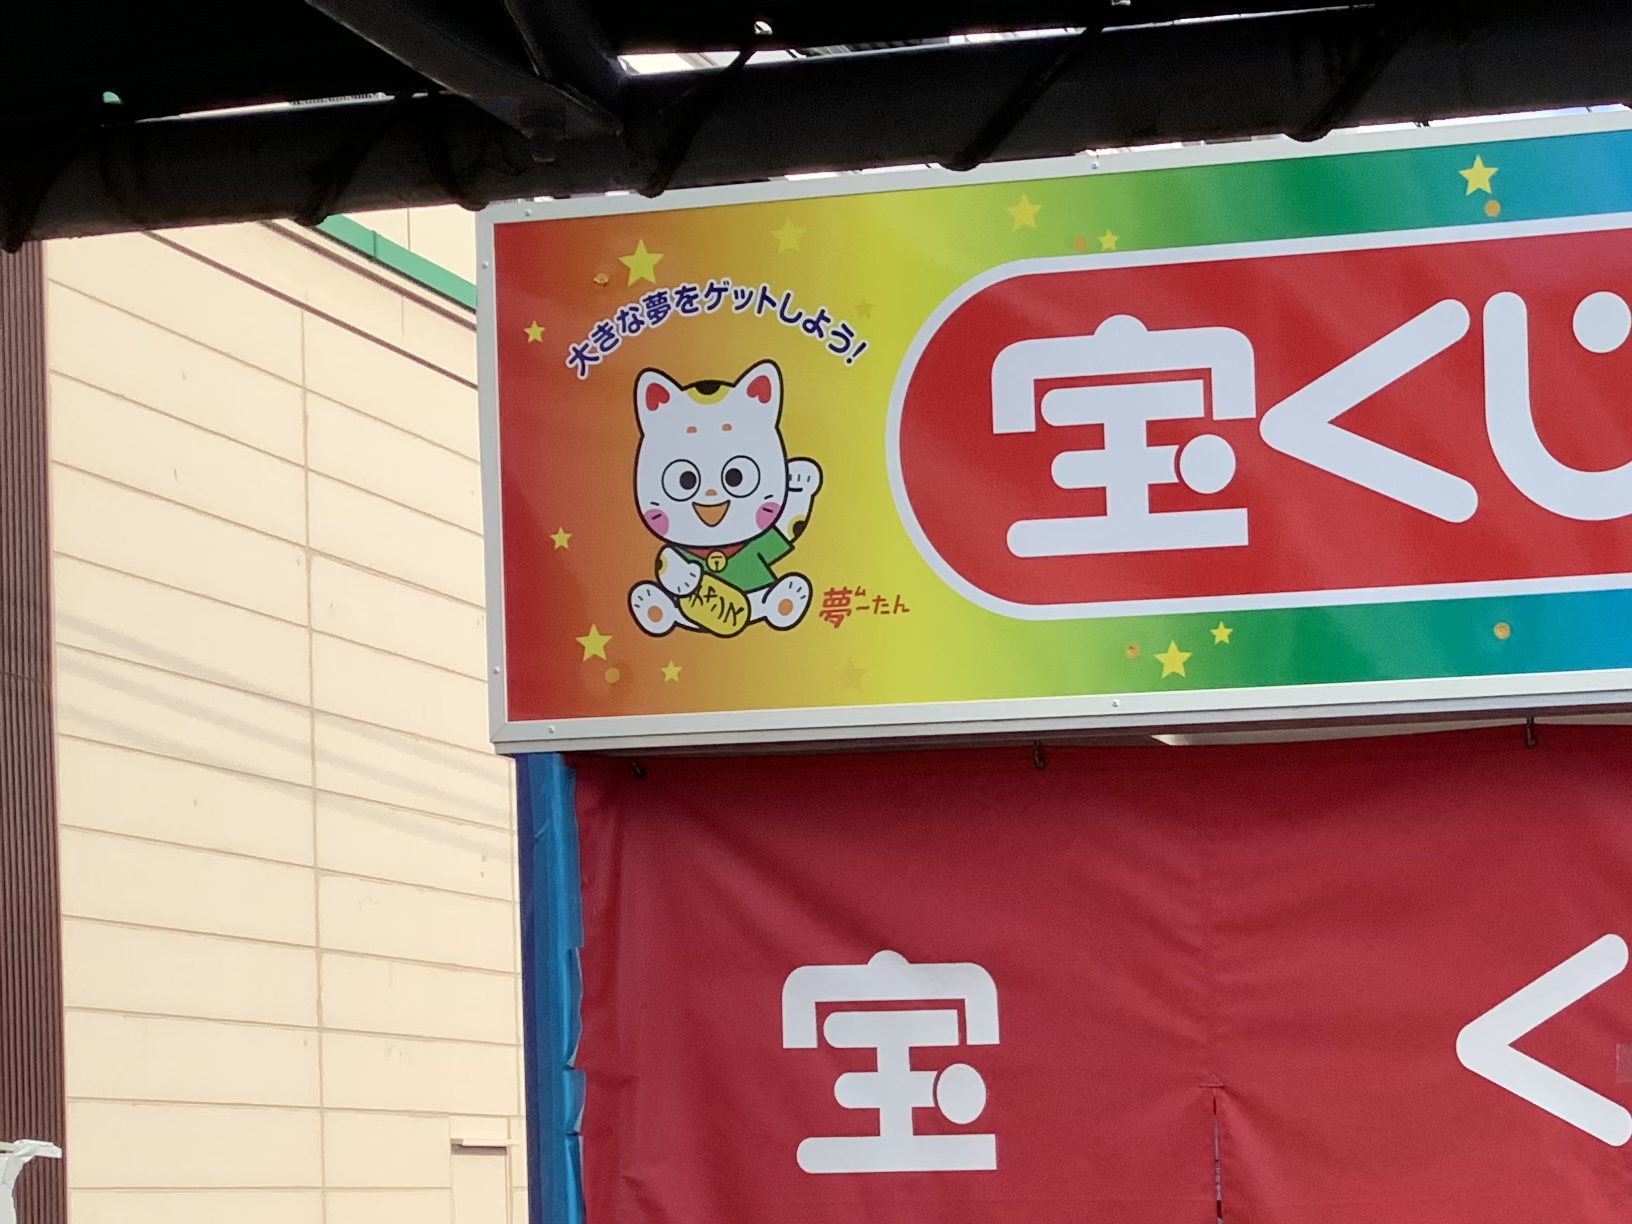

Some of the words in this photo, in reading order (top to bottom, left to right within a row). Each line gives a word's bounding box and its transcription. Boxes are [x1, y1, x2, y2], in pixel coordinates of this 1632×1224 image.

[567, 280, 868, 377] 大きな夢をゲットしよう!
[781, 949, 1001, 1175] 宝
